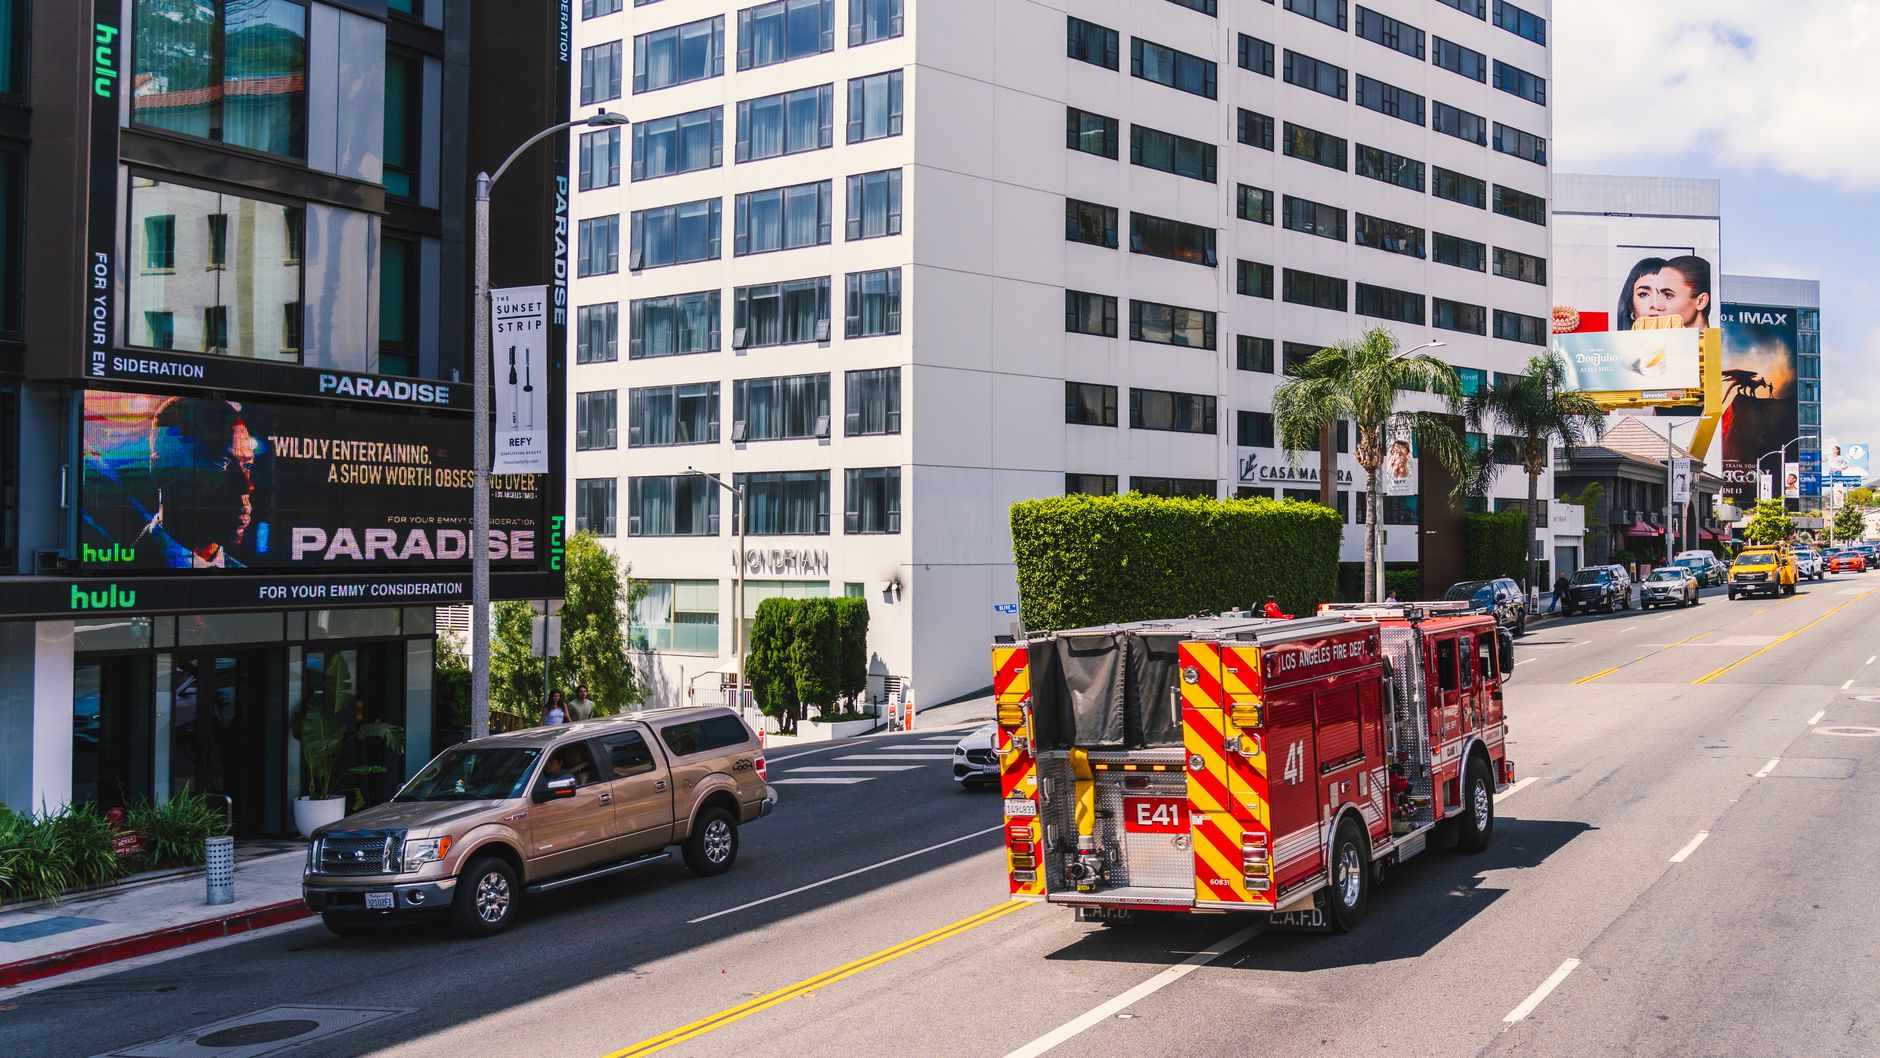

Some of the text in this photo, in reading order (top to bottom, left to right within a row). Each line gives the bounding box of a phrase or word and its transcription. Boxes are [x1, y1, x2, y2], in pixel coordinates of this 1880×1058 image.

[95, 23, 118, 98] hulu
[554, 175, 568, 325] PARADISE
[92, 252, 108, 376] FOR YOUR EM
[496, 302, 542, 315] SUNSET
[1720, 311, 1788, 325] OR IMAX
[498, 319, 542, 333] STRIP
[113, 357, 205, 378] SIDERATION
[319, 374, 450, 404] PARADISE
[268, 436, 432, 465] "WILDLY ENTERTAINING.
[509, 437, 532, 447] REFY
[327, 463, 542, 491] A SHOW WORTH OBSESNG OVER."
[1260, 466, 1353, 482] CASA MARA
[387, 516, 407, 524] FOR
[409, 516, 435, 524] YOUR
[83, 543, 135, 562] hulu
[291, 528, 535, 560] PARADISE
[551, 515, 565, 571] hulu
[731, 549, 828, 573] MONDRIAN
[71, 584, 136, 609] hulu
[259, 586, 287, 599] FOR
[291, 585, 326, 598] YOUR
[371, 583, 462, 596] CONSIDERATION
[1281, 640, 1367, 671] LOS ANGELES FIRE DEPT.
[1283, 740, 1304, 785] 41
[1136, 803, 1179, 826] E41
[1209, 878, 1231, 886] 60831
[1270, 908, 1327, 927] L.A.F.D.
